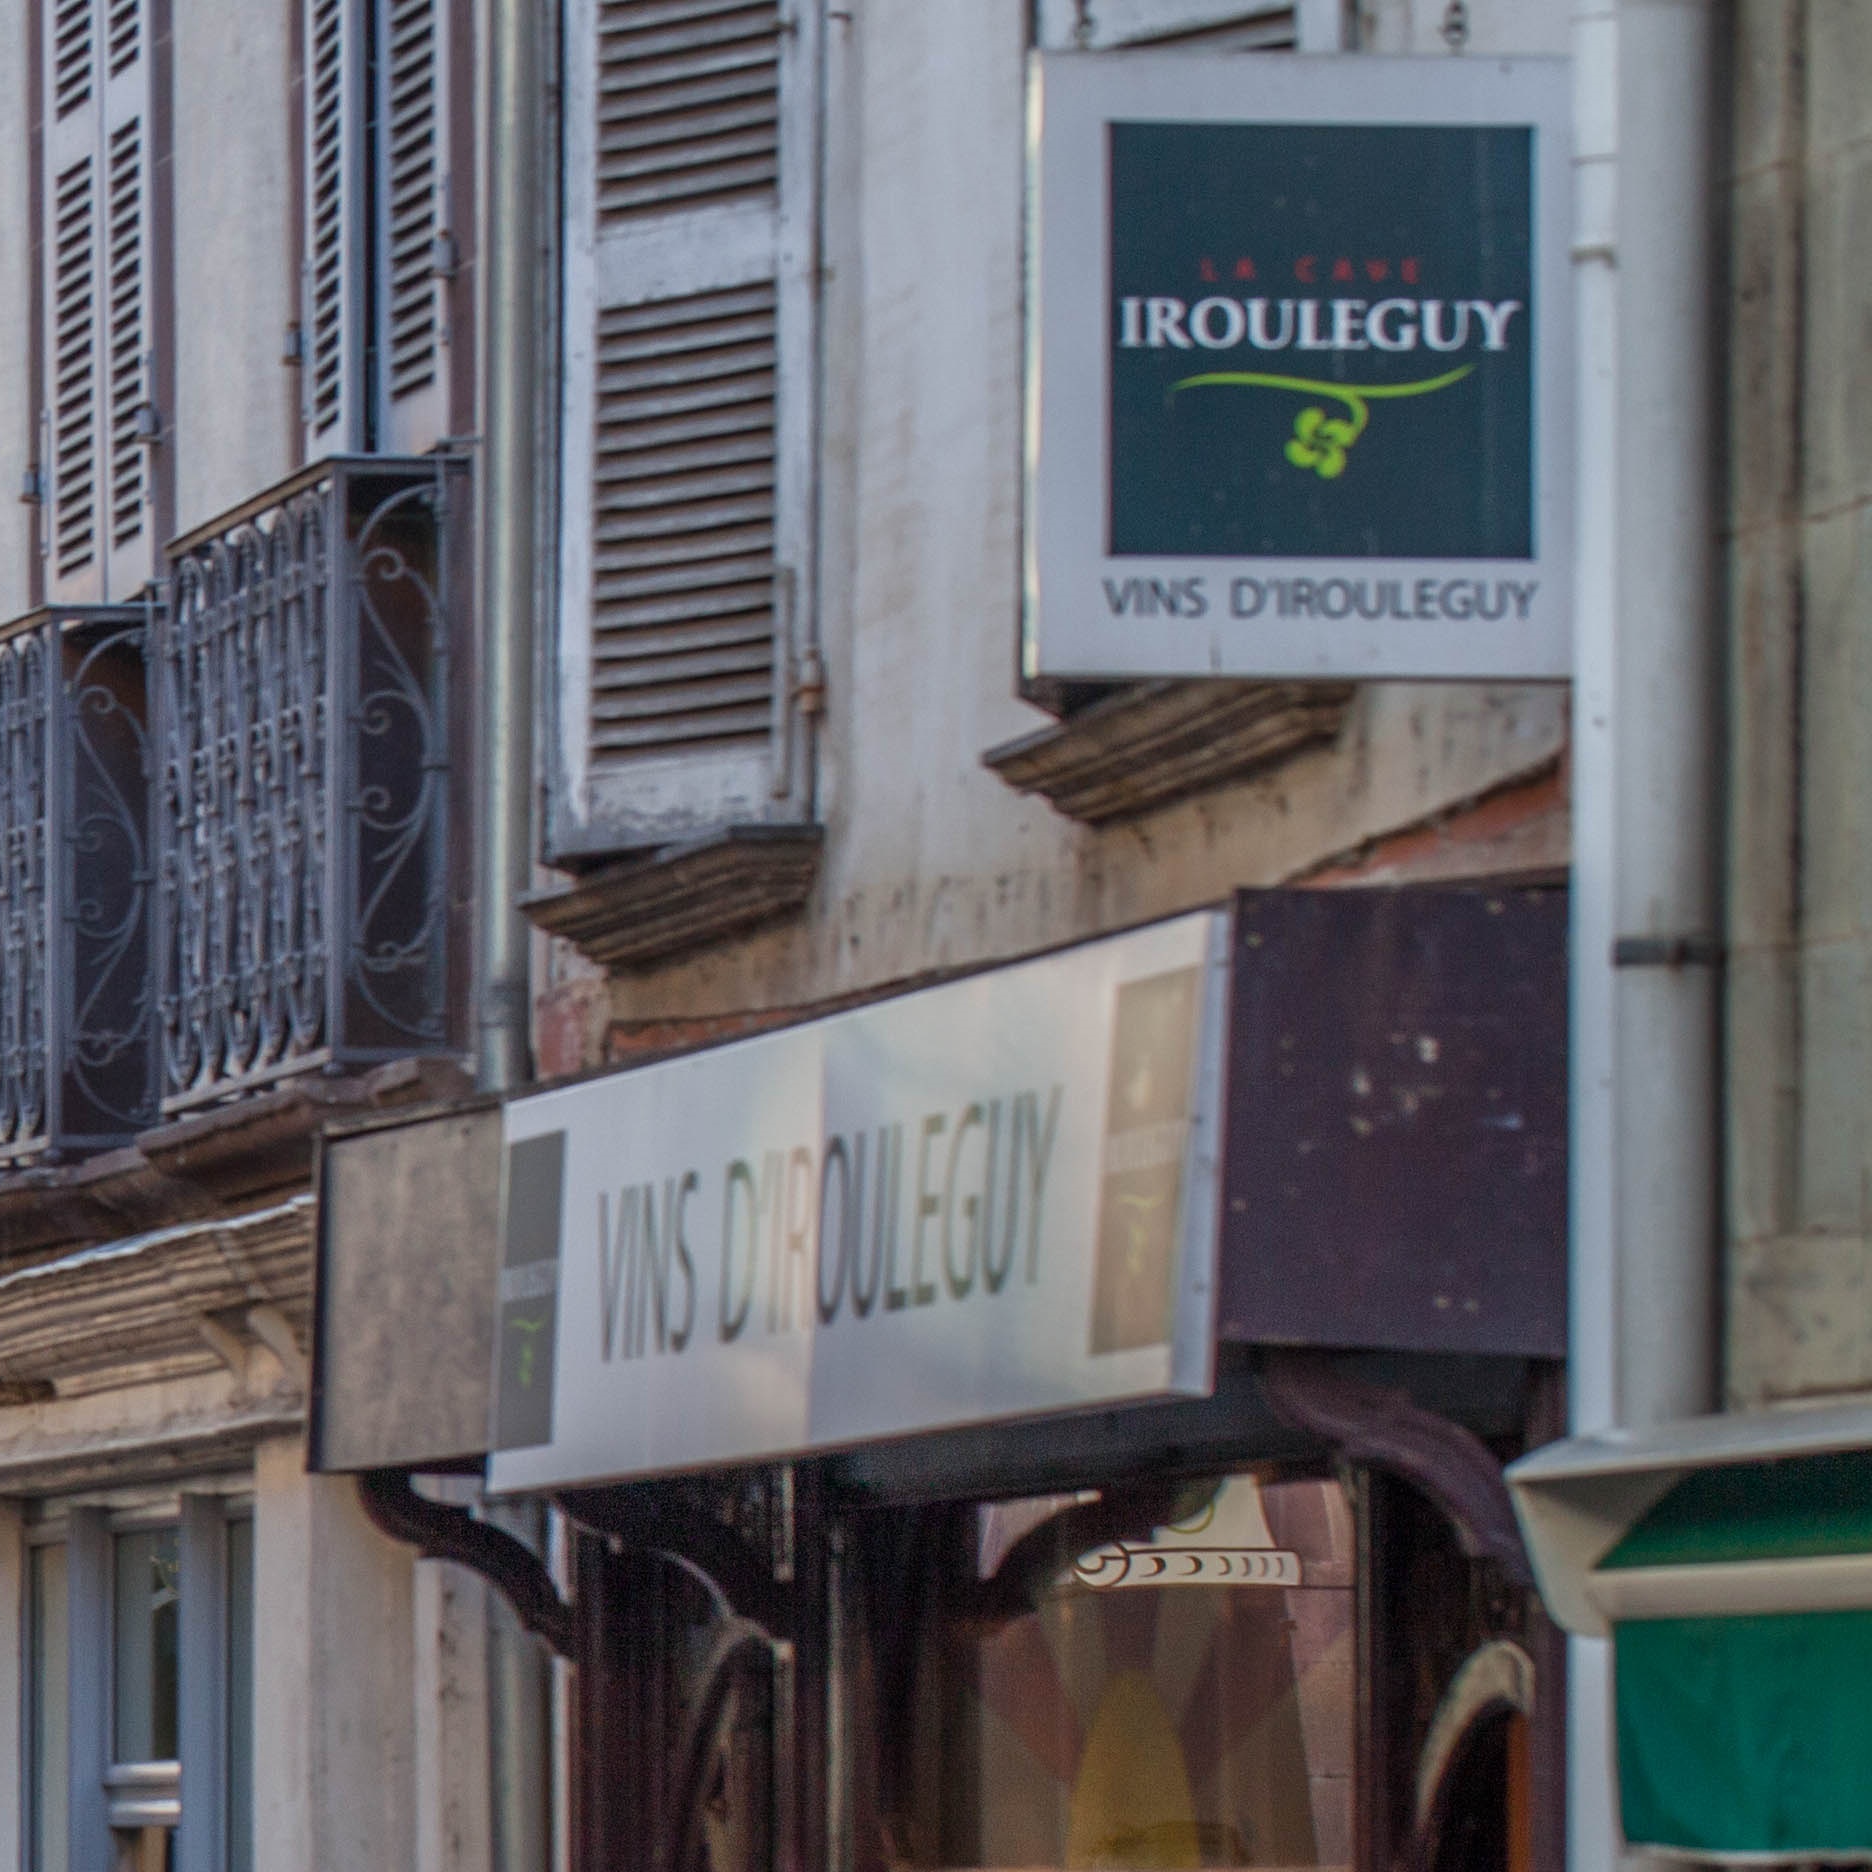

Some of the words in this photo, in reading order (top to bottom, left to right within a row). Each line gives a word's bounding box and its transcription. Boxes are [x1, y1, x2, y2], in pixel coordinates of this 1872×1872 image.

[1199, 255, 1256, 283] LA
[1294, 255, 1421, 285] CAVE
[1117, 296, 1523, 352] IROULEGUY
[1101, 576, 1209, 619] VINS
[1229, 576, 1540, 621] D'IROULEGUY
[596, 1170, 701, 1363] VINS
